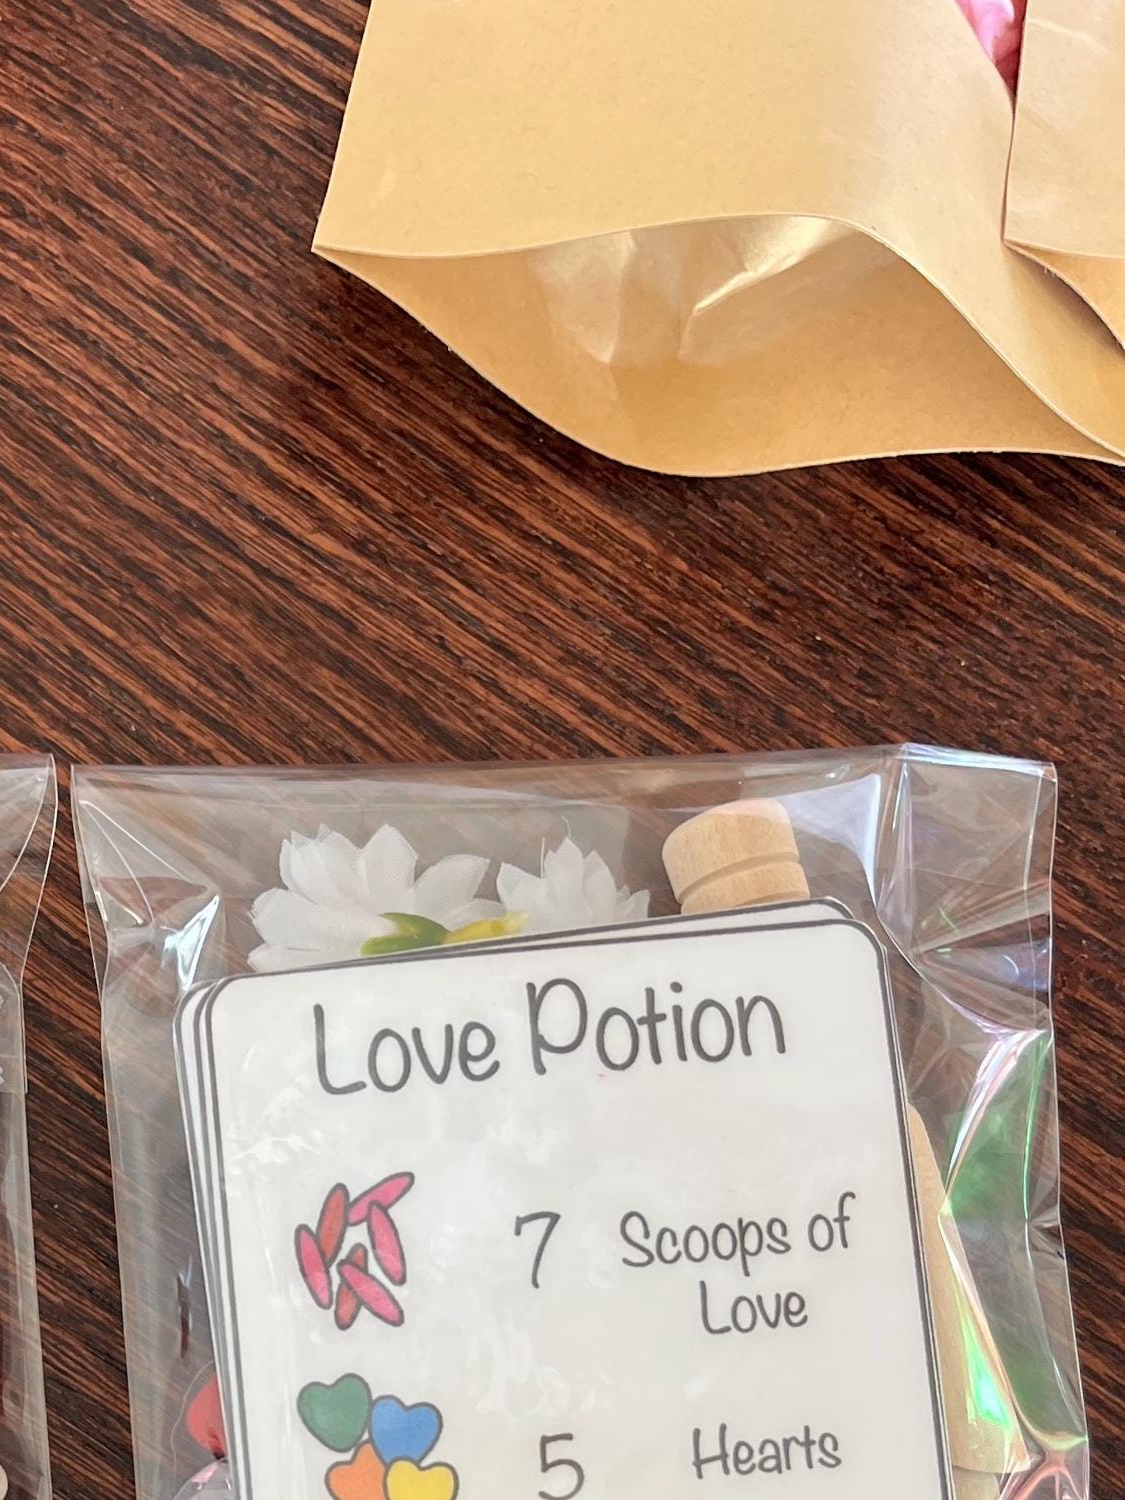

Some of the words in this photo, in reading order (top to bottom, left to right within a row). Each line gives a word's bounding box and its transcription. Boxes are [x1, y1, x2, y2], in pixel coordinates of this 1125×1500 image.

[313, 1003, 500, 1095] Love
[525, 977, 786, 1075] Potion
[514, 1211, 561, 1288] 7
[619, 1211, 791, 1276] Scoops
[808, 1192, 856, 1251] of
[698, 1281, 808, 1334] Love
[692, 1423, 841, 1479] Hearts
